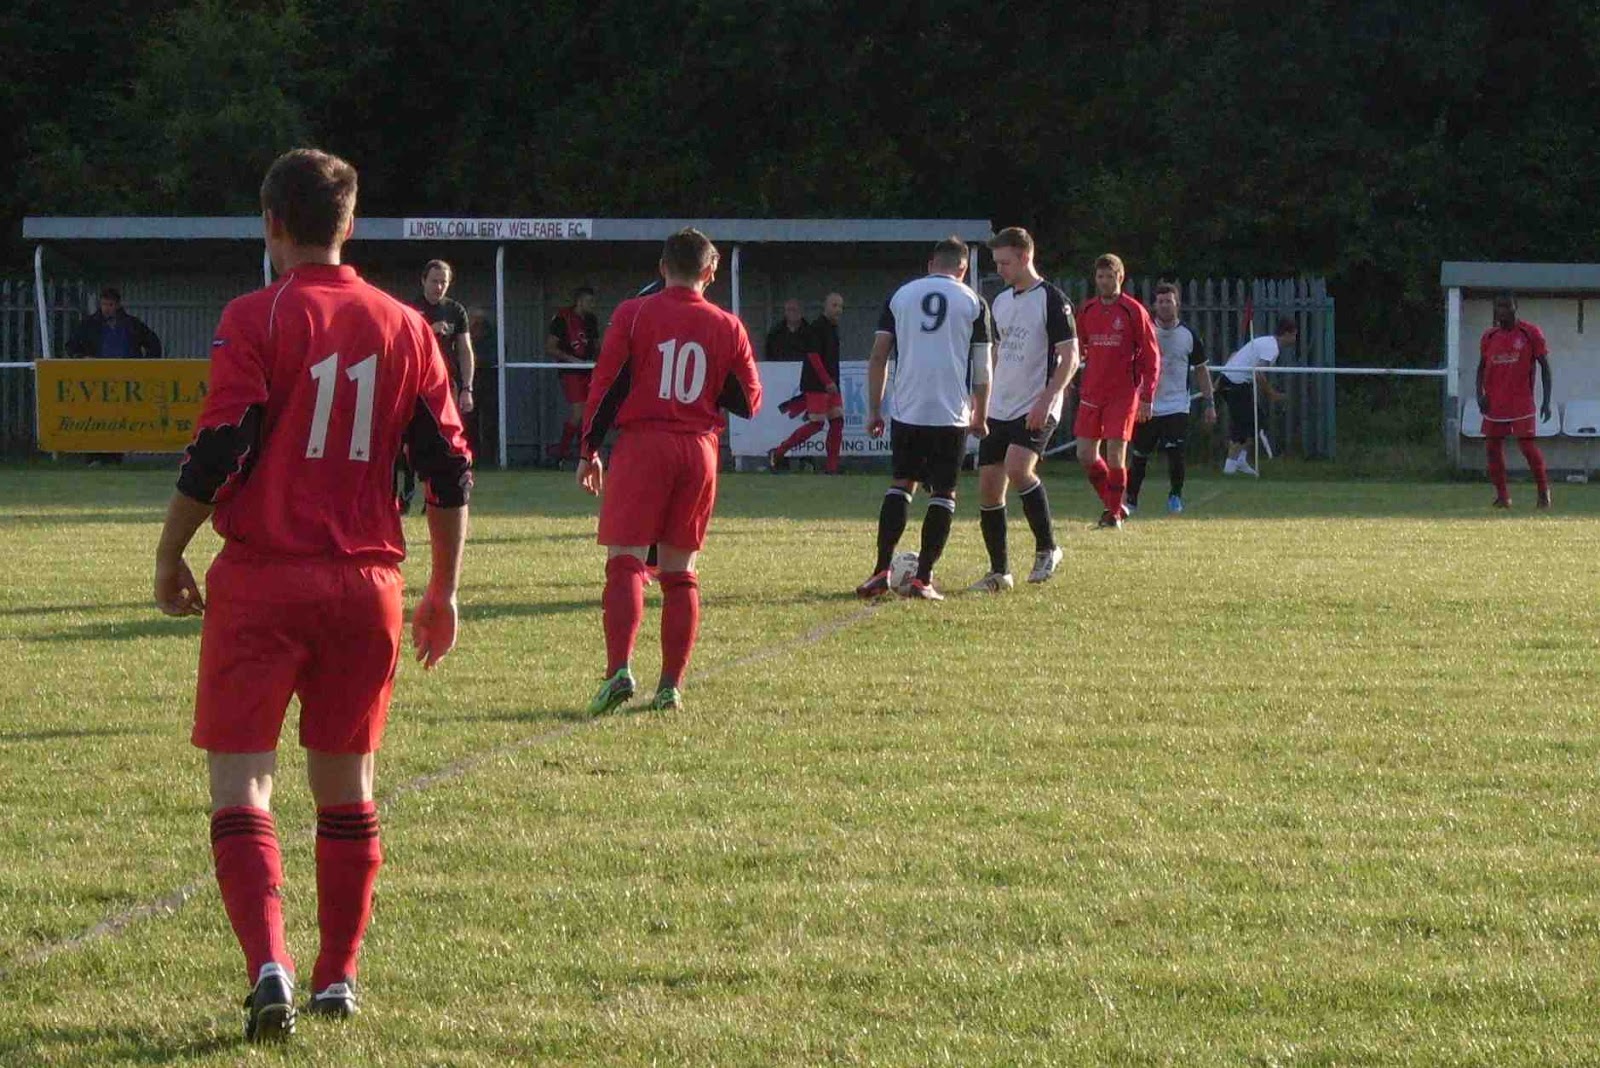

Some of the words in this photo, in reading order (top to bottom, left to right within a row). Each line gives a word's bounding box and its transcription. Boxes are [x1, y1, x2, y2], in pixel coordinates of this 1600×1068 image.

[410, 221, 442, 237] LINBY
[448, 221, 502, 237] COLLIERY
[509, 221, 563, 238] WELFARE
[921, 292, 947, 332] 9
[57, 379, 144, 403] EVER
[657, 338, 707, 404] 10
[305, 352, 377, 462] 11
